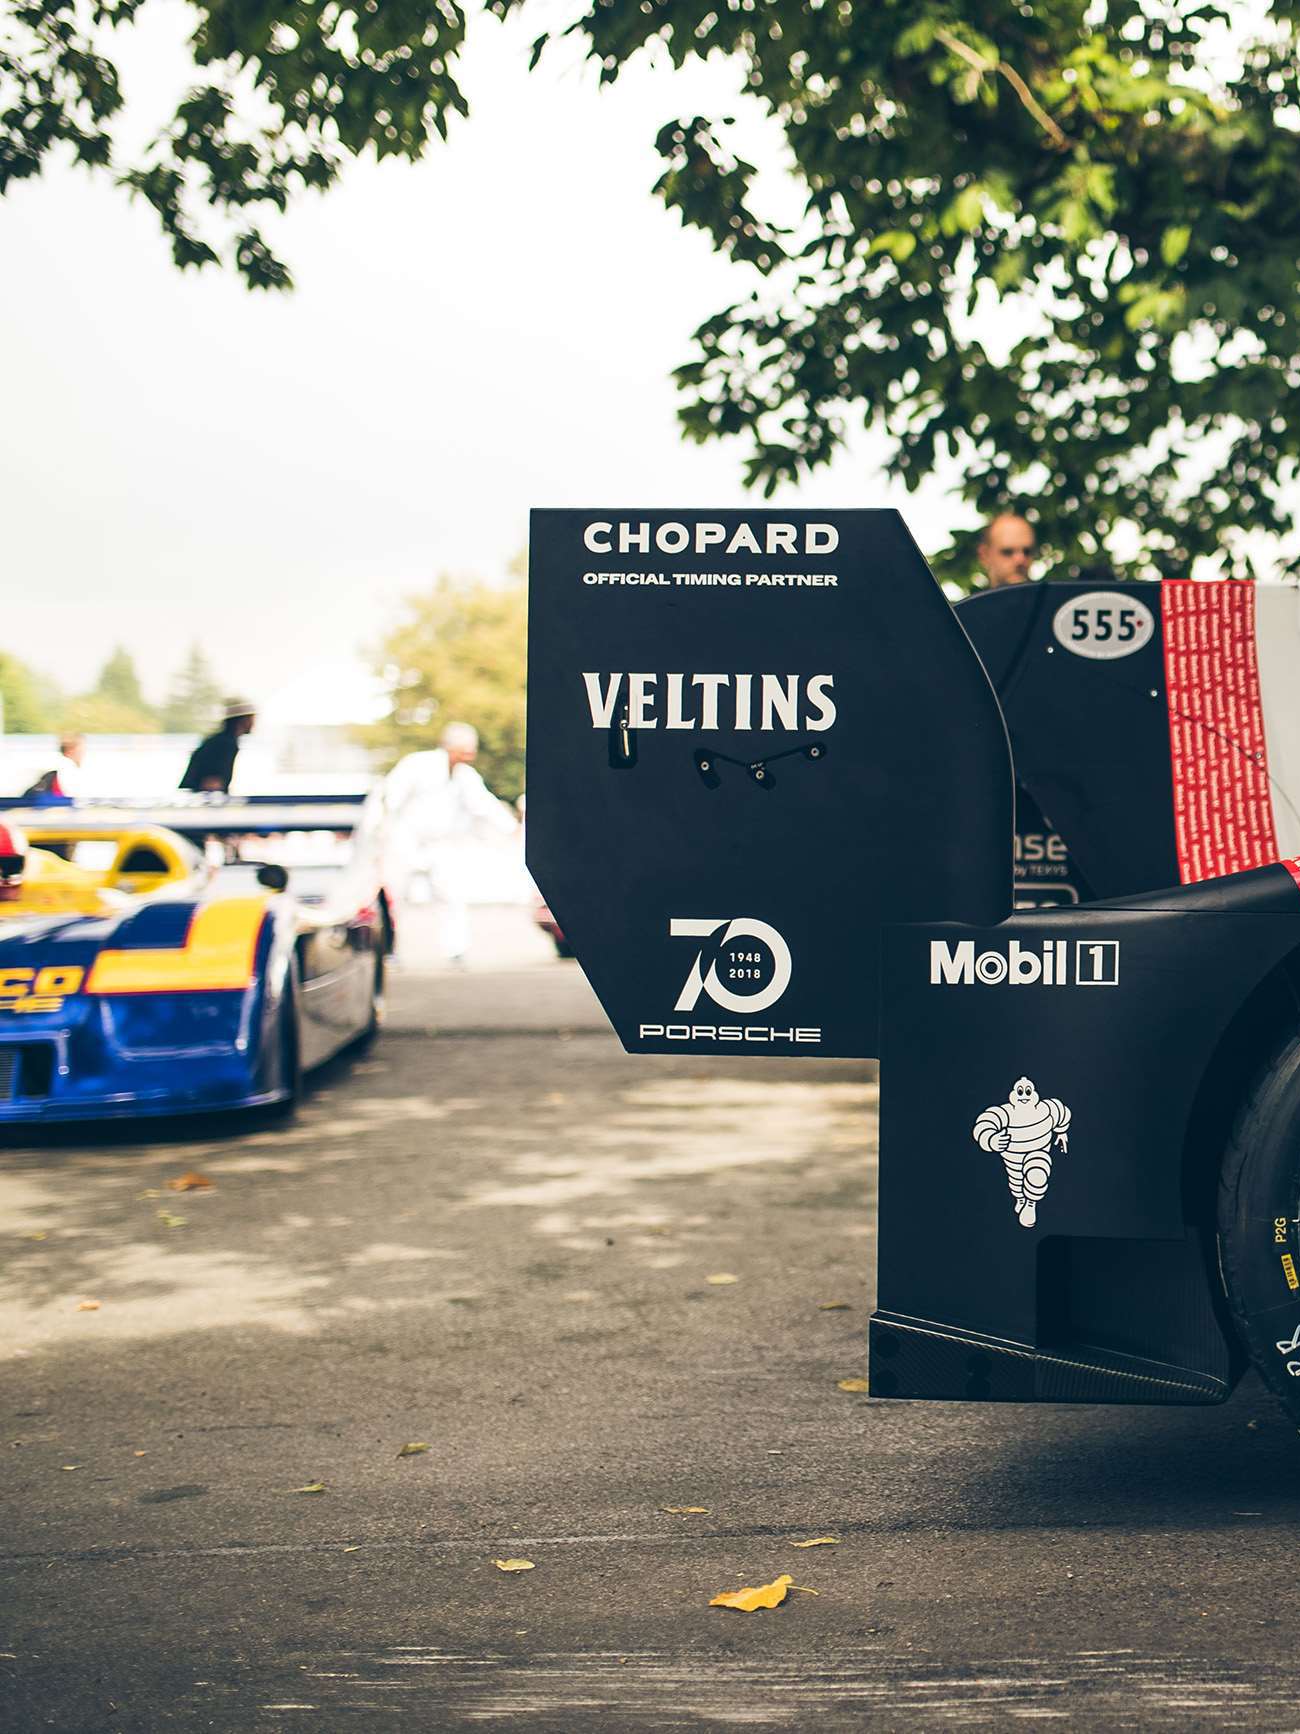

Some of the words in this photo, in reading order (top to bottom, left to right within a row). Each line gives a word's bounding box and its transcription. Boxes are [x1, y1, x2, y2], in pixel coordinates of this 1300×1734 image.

[583, 521, 839, 555] CHOPARD
[582, 572, 670, 586] OFFICIAL
[672, 573, 742, 587] TIMING
[745, 574, 839, 587] PARTNER
[1071, 609, 1136, 641] 555
[582, 672, 837, 732] VELTINS
[670, 917, 792, 1014] 70
[729, 952, 761, 963] 1948
[930, 940, 1068, 986] Mobil
[729, 968, 761, 979] 2018
[639, 1024, 822, 1043] PORSCHE
[1274, 1217, 1287, 1243] P2G
